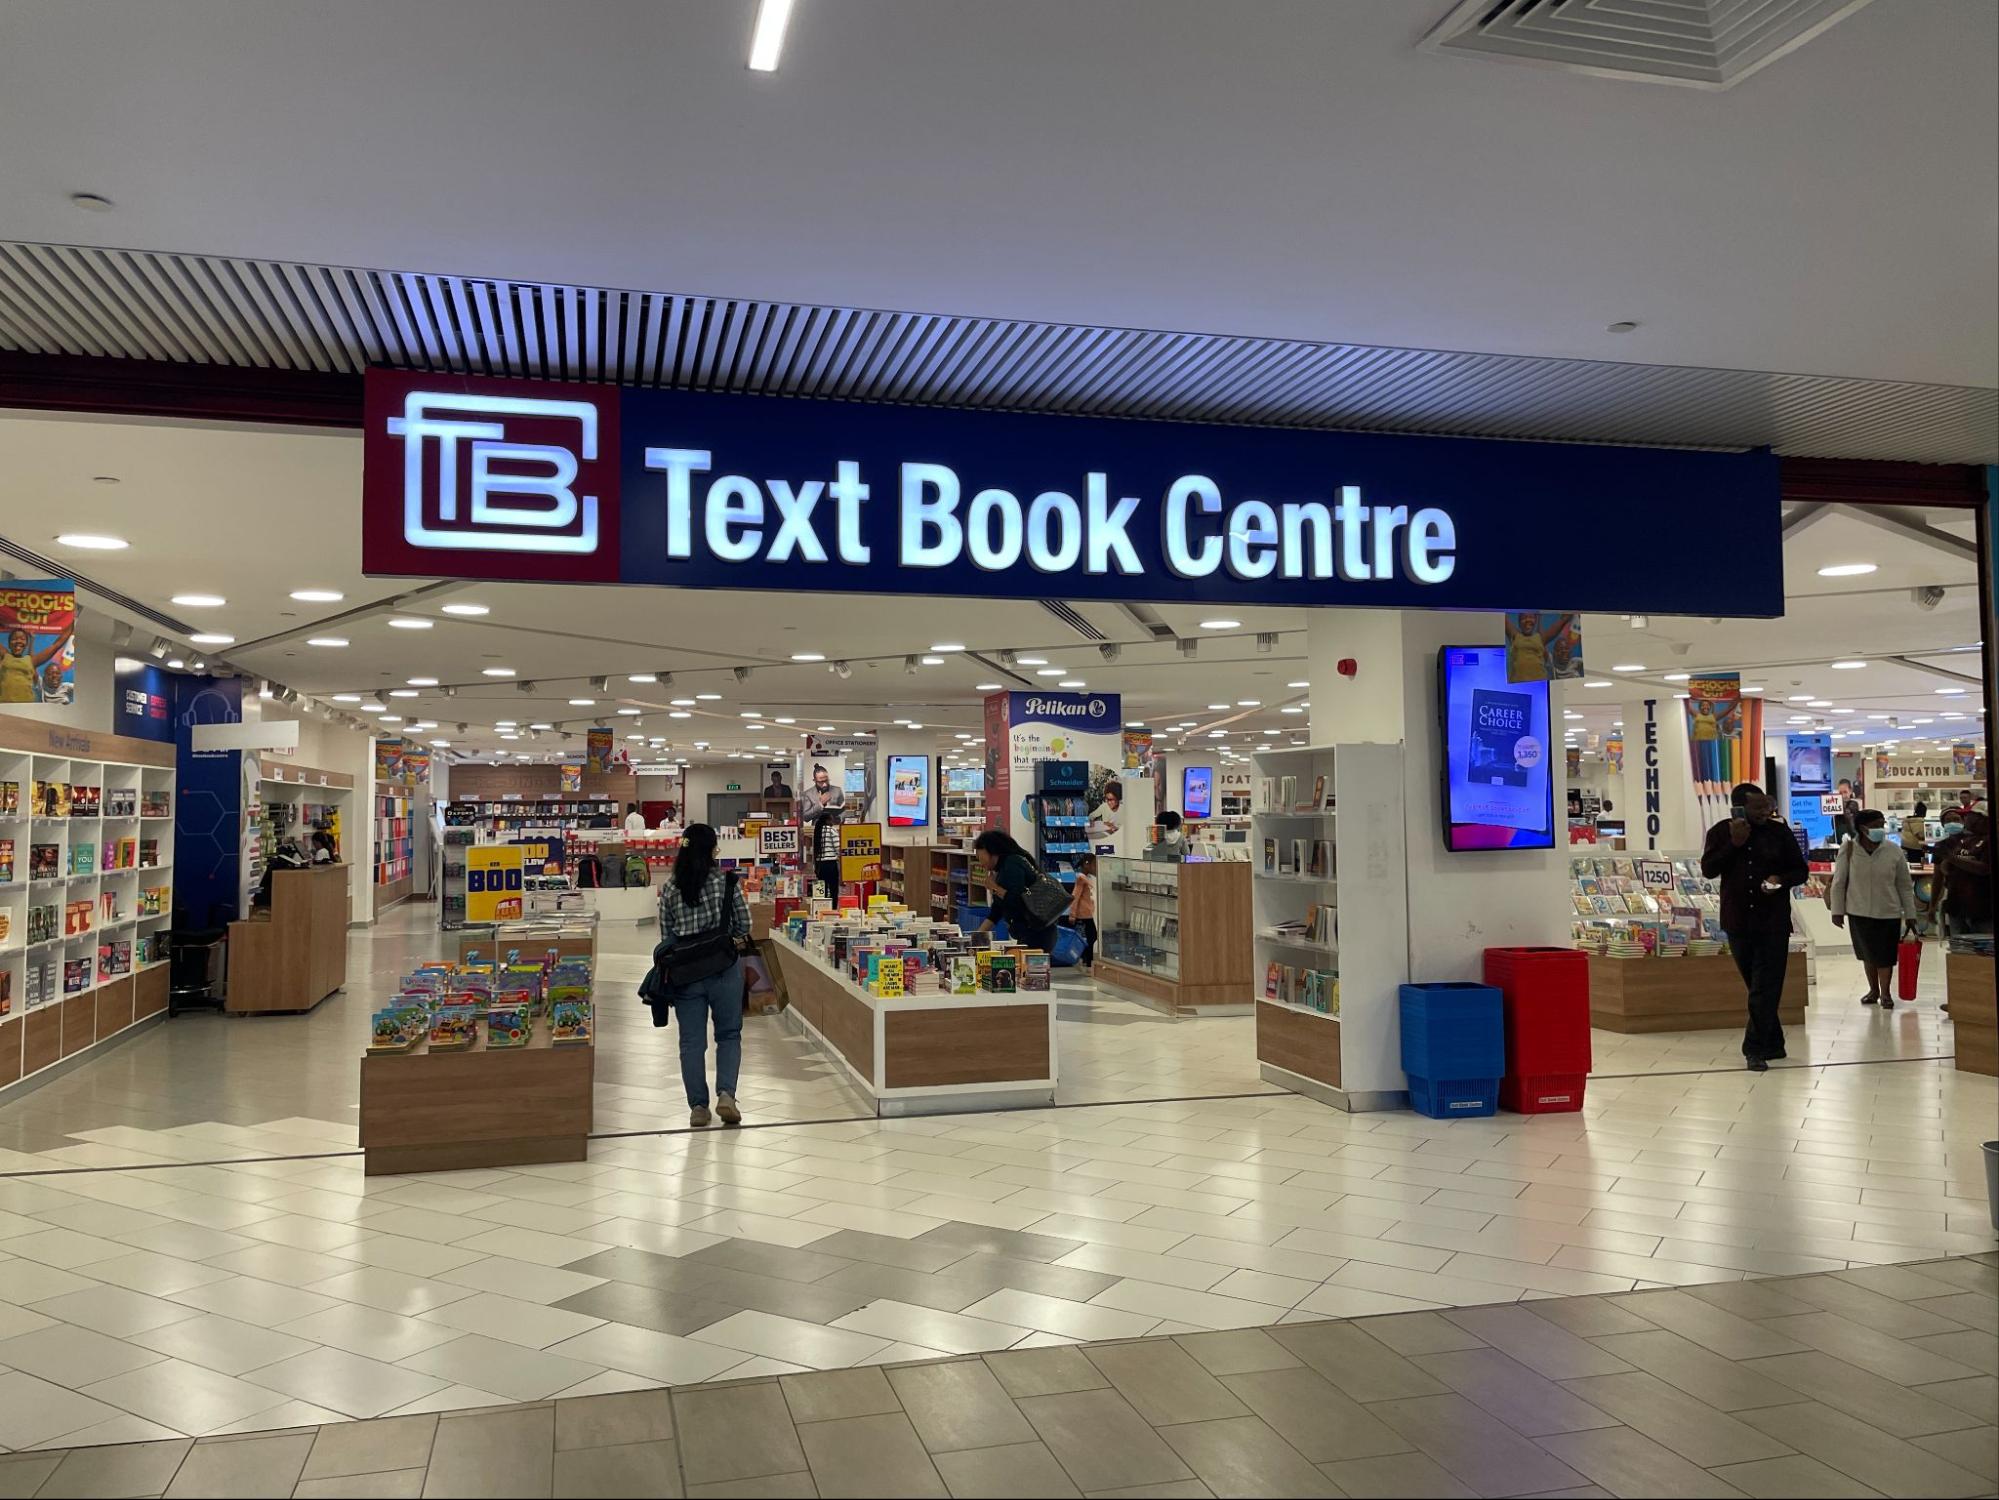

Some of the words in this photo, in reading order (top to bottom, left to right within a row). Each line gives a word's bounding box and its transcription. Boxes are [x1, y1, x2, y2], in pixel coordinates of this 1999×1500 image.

[645, 447, 871, 563] Text
[900, 462, 1145, 574] Book
[1162, 474, 1457, 585] Centre
[1025, 698, 1087, 716] Pelikan
[1480, 705, 1523, 720] CAREER
[1480, 715, 1522, 728] CHOICE
[1013, 734, 1025, 742] It's
[1028, 734, 1040, 742] the
[1014, 755, 1028, 764] that
[1049, 778, 1084, 787] Schneider
[764, 831, 796, 842] BEST
[764, 842, 796, 850] SELLERS
[847, 839, 874, 848] BEST
[841, 848, 880, 857] SELLER
[468, 869, 522, 892] 800
[1645, 870, 1670, 884] 1250
